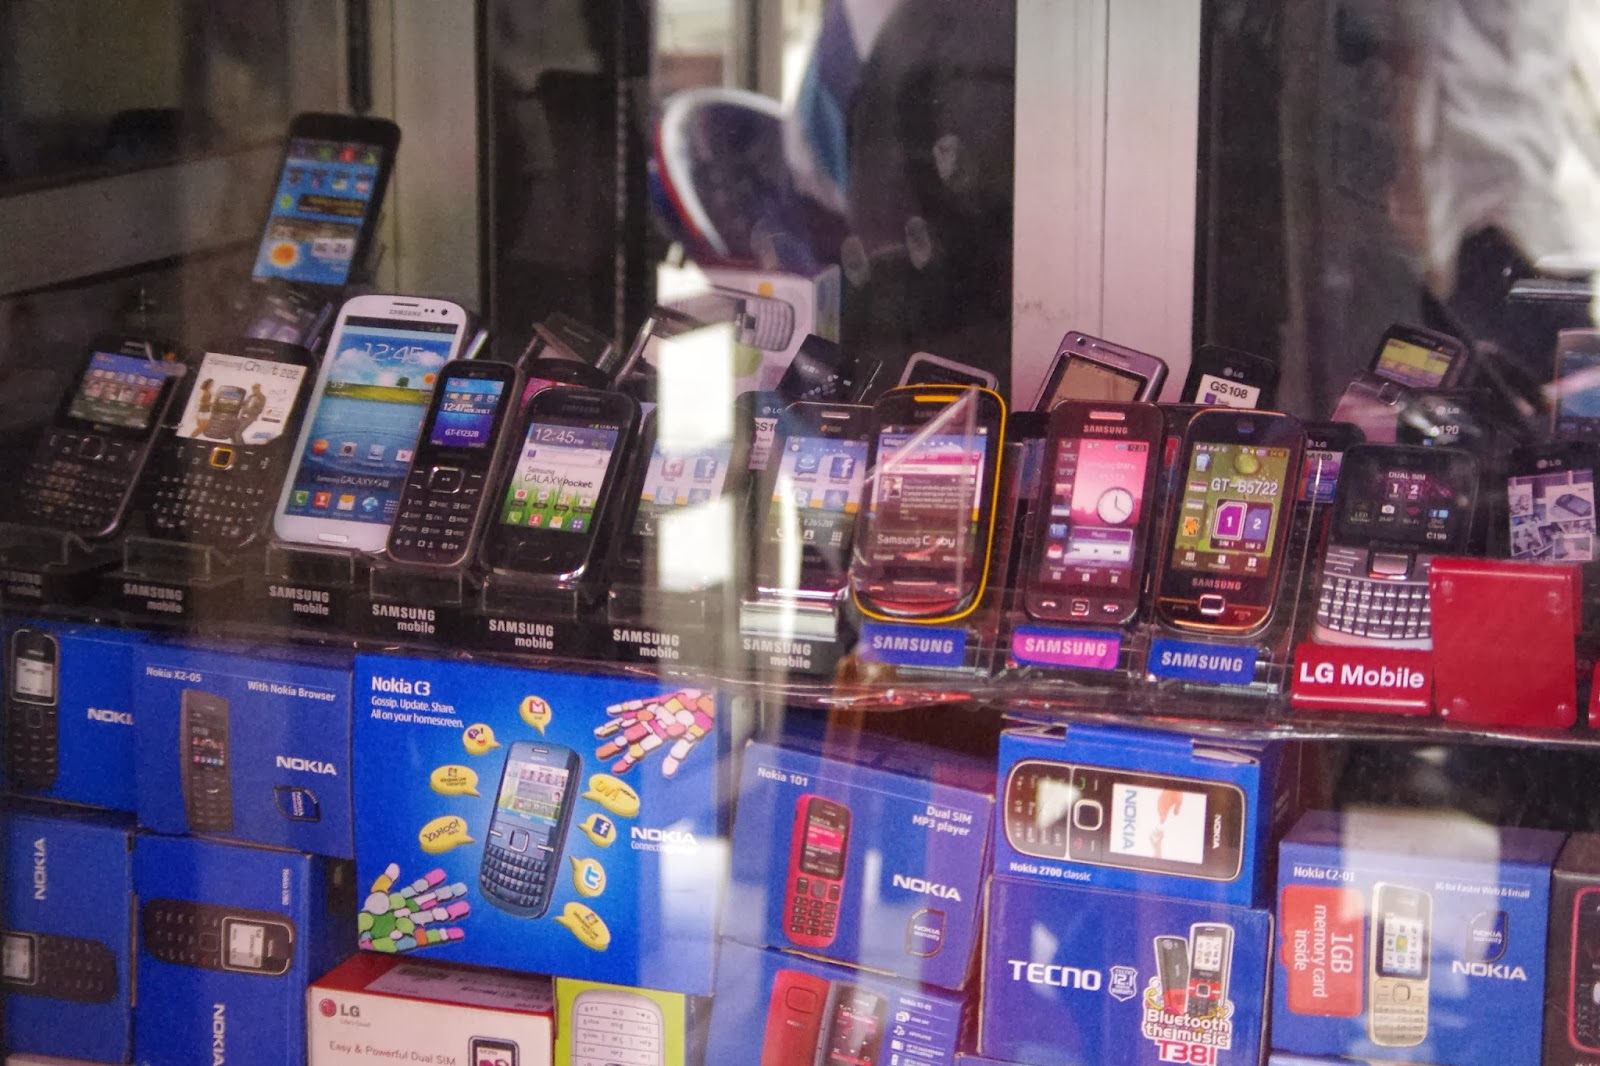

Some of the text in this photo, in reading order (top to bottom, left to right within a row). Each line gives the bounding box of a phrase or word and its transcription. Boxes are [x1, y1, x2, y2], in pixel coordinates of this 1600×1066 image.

[365, 342, 424, 365] 12:45
[1210, 381, 1248, 399] GS108
[535, 428, 575, 444] 12:45
[1083, 425, 1128, 434] SAMSUNG
[877, 534, 920, 549] Samsung
[123, 583, 184, 602] SAMSUNG
[1191, 577, 1242, 591] SAMSUNG
[268, 585, 330, 604] SAMSUNG
[293, 602, 330, 616] mobile
[372, 603, 436, 622] SAMSUNG
[397, 621, 436, 634] mobile
[488, 619, 554, 637] SAMSUNG
[515, 637, 554, 650] mobile
[613, 629, 680, 647] SAMSUNG
[743, 638, 812, 656] SAMSUNG
[873, 634, 954, 653] SAMSUNG
[639, 646, 680, 660] mobile
[1024, 641, 1108, 658] SAMSUNG
[769, 654, 811, 669] mobile
[1161, 650, 1244, 672] SAMSUNG
[146, 666, 172, 679] Nokia
[1299, 662, 1425, 688] LG Mobile
[247, 680, 337, 702] With Nokia Browser
[371, 676, 432, 696] Nokia C3
[371, 695, 456, 714] Gossip. Update. Share.
[86, 708, 134, 725] NOKI
[371, 708, 464, 728] All on your homescreen.
[276, 756, 337, 776] NOKIA
[757, 767, 808, 787] Nokia 101
[926, 805, 972, 824] Dual SIM
[1122, 789, 1137, 850] NOKIA
[912, 815, 971, 836] MP3 player
[1212, 814, 1221, 849] NOKIA
[630, 826, 697, 845] NOKIA
[34, 837, 47, 900] NOKIA
[1010, 861, 1091, 882] Nokia 2700 classic
[1293, 866, 1355, 882] Nokia C2-01
[893, 873, 962, 902] NOKIA
[1293, 929, 1311, 971] inside
[1310, 904, 1329, 998] memory card
[1330, 932, 1354, 973] 1GB
[1008, 959, 1102, 991] TECNO
[1452, 960, 1527, 981] NOKIA
[340, 1004, 360, 1018] LG
[1147, 1009, 1230, 1033] Bluetooth
[213, 1004, 226, 1066] NOKIA
[329, 1040, 456, 1066] Easy & Powerful Dual SIM
